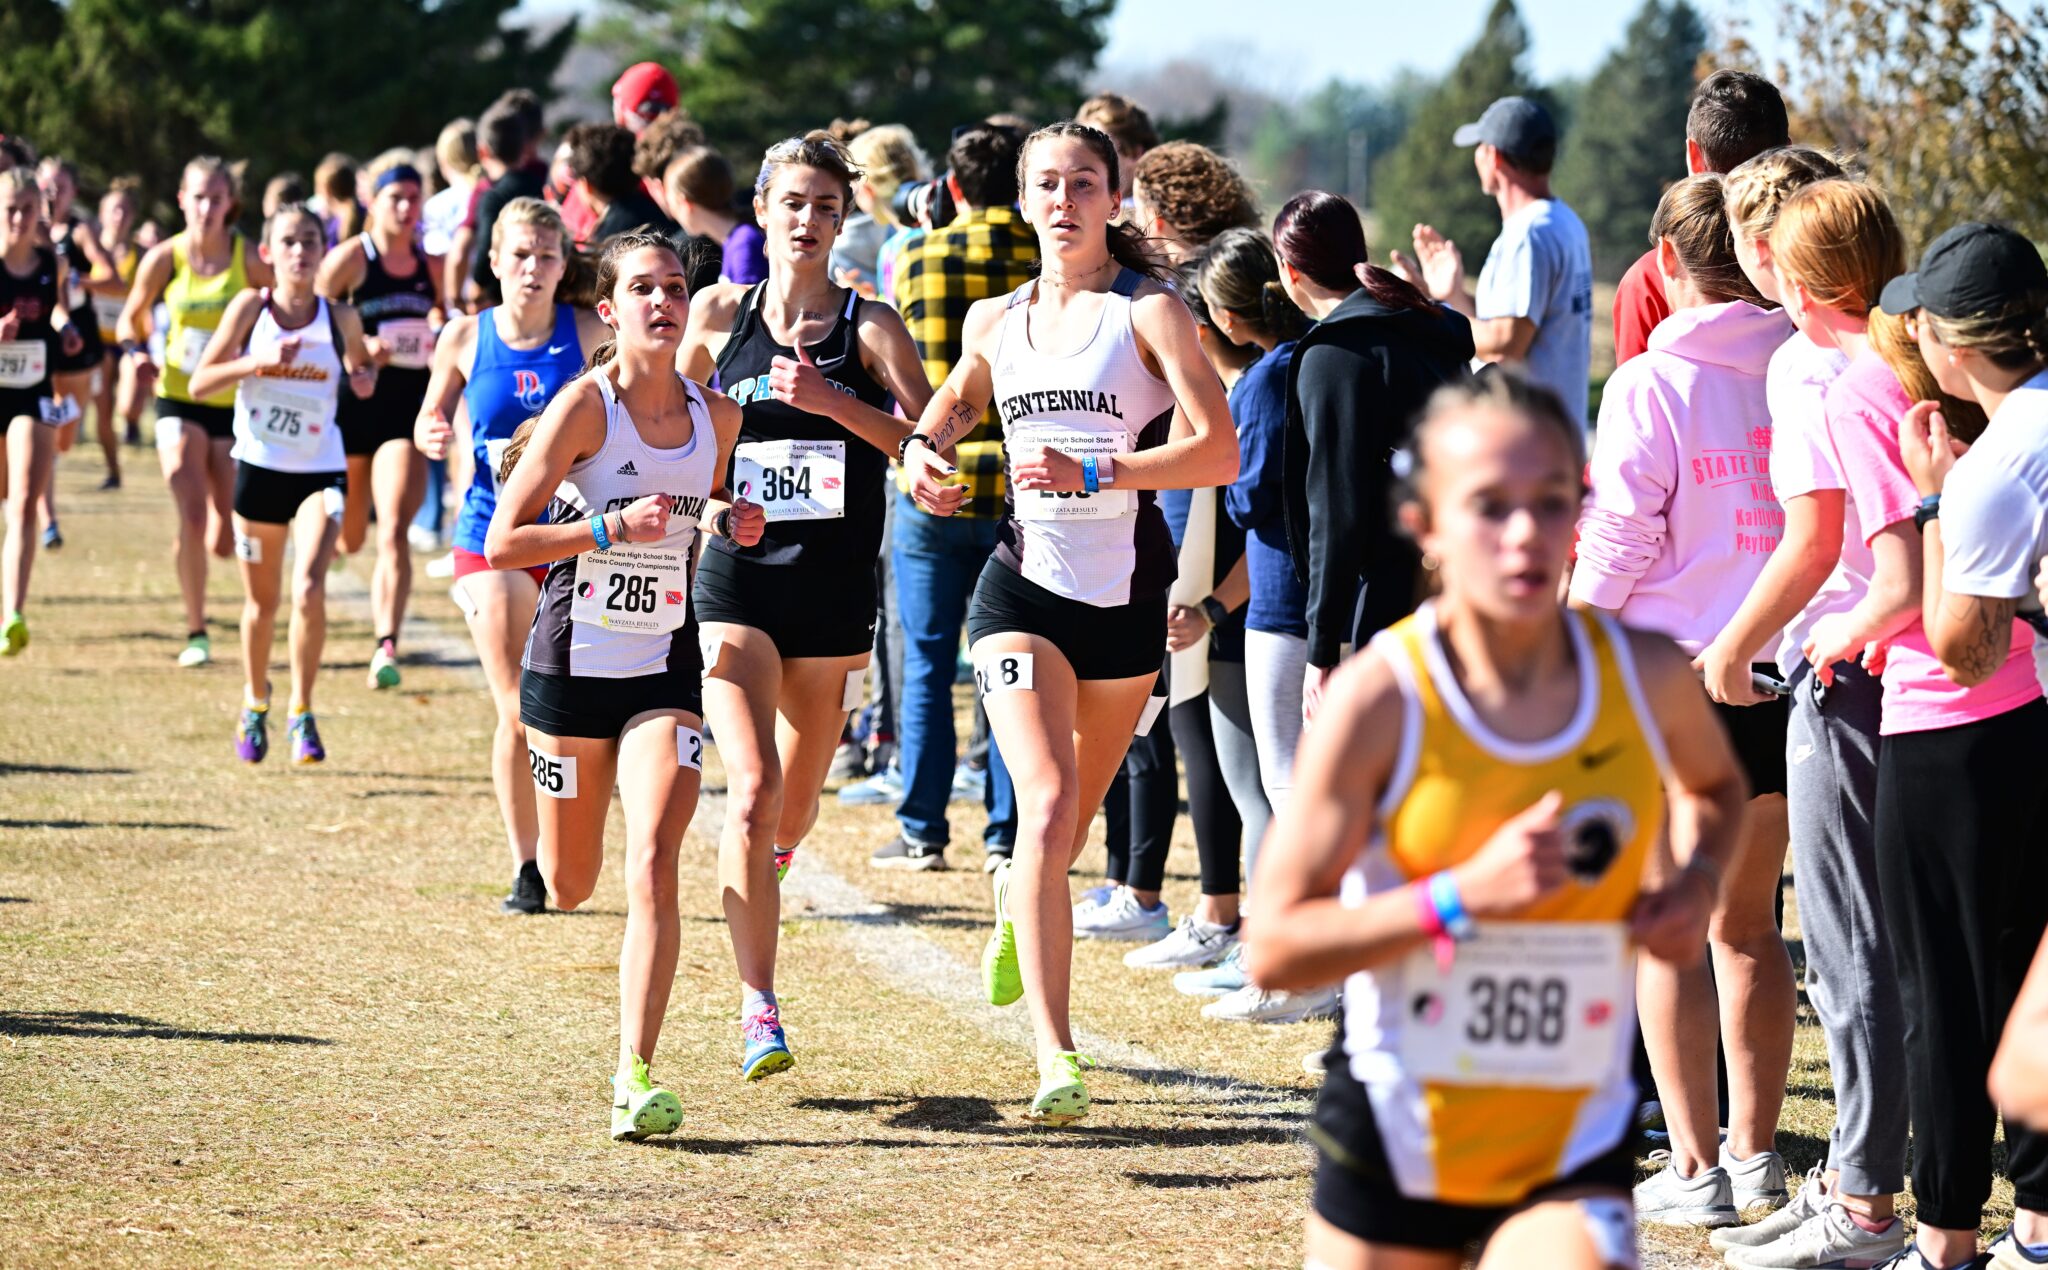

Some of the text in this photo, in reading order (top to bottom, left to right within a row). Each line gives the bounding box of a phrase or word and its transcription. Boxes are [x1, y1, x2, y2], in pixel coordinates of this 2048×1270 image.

[266, 405, 302, 437] 275
[1001, 389, 1124, 426] CENTENNIAL
[1053, 436, 1069, 444] High
[1070, 436, 1095, 444] School
[1095, 436, 1114, 444] State
[1064, 446, 1119, 455] Championships
[616, 469, 639, 477] adidas
[762, 465, 812, 502] 364
[1692, 455, 1749, 485] STATE
[587, 556, 680, 572] Cross Country Championships
[609, 550, 626, 558] Iowa
[627, 552, 642, 560] High
[664, 554, 678, 562] State
[606, 573, 658, 614] 285
[528, 749, 564, 793] 285
[1466, 976, 1568, 1046] 368
